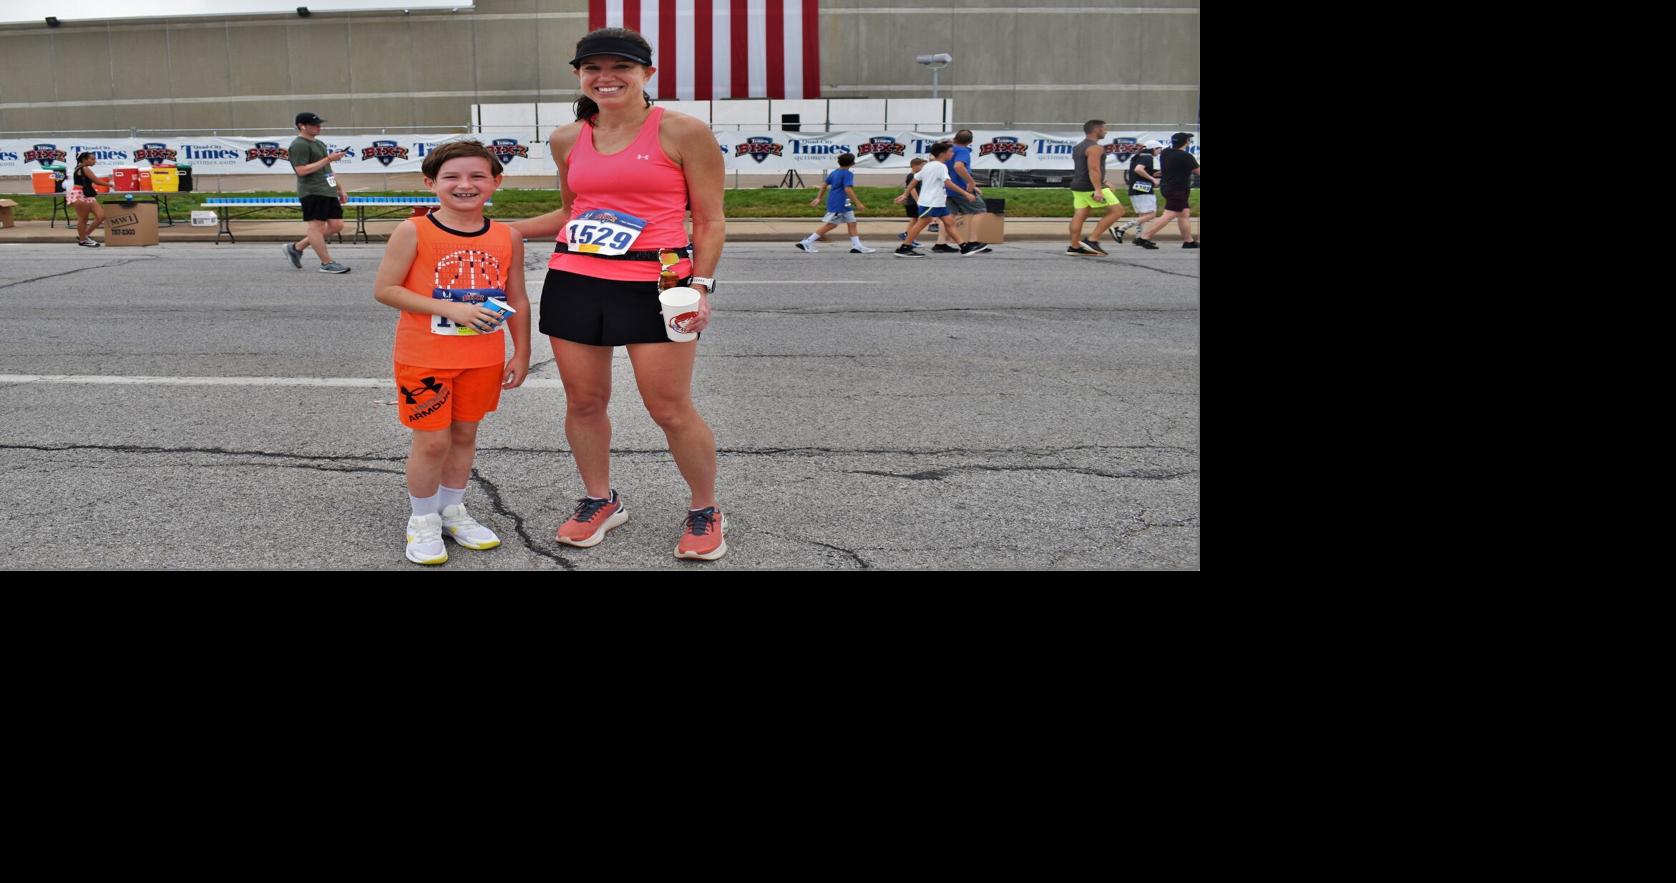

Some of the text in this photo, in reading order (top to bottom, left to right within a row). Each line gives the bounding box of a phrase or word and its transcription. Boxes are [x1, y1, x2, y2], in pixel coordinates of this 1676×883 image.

[181, 145, 239, 159] Times
[788, 139, 851, 154] Times
[1034, 139, 1073, 154] Tim
[569, 224, 633, 250] 1529
